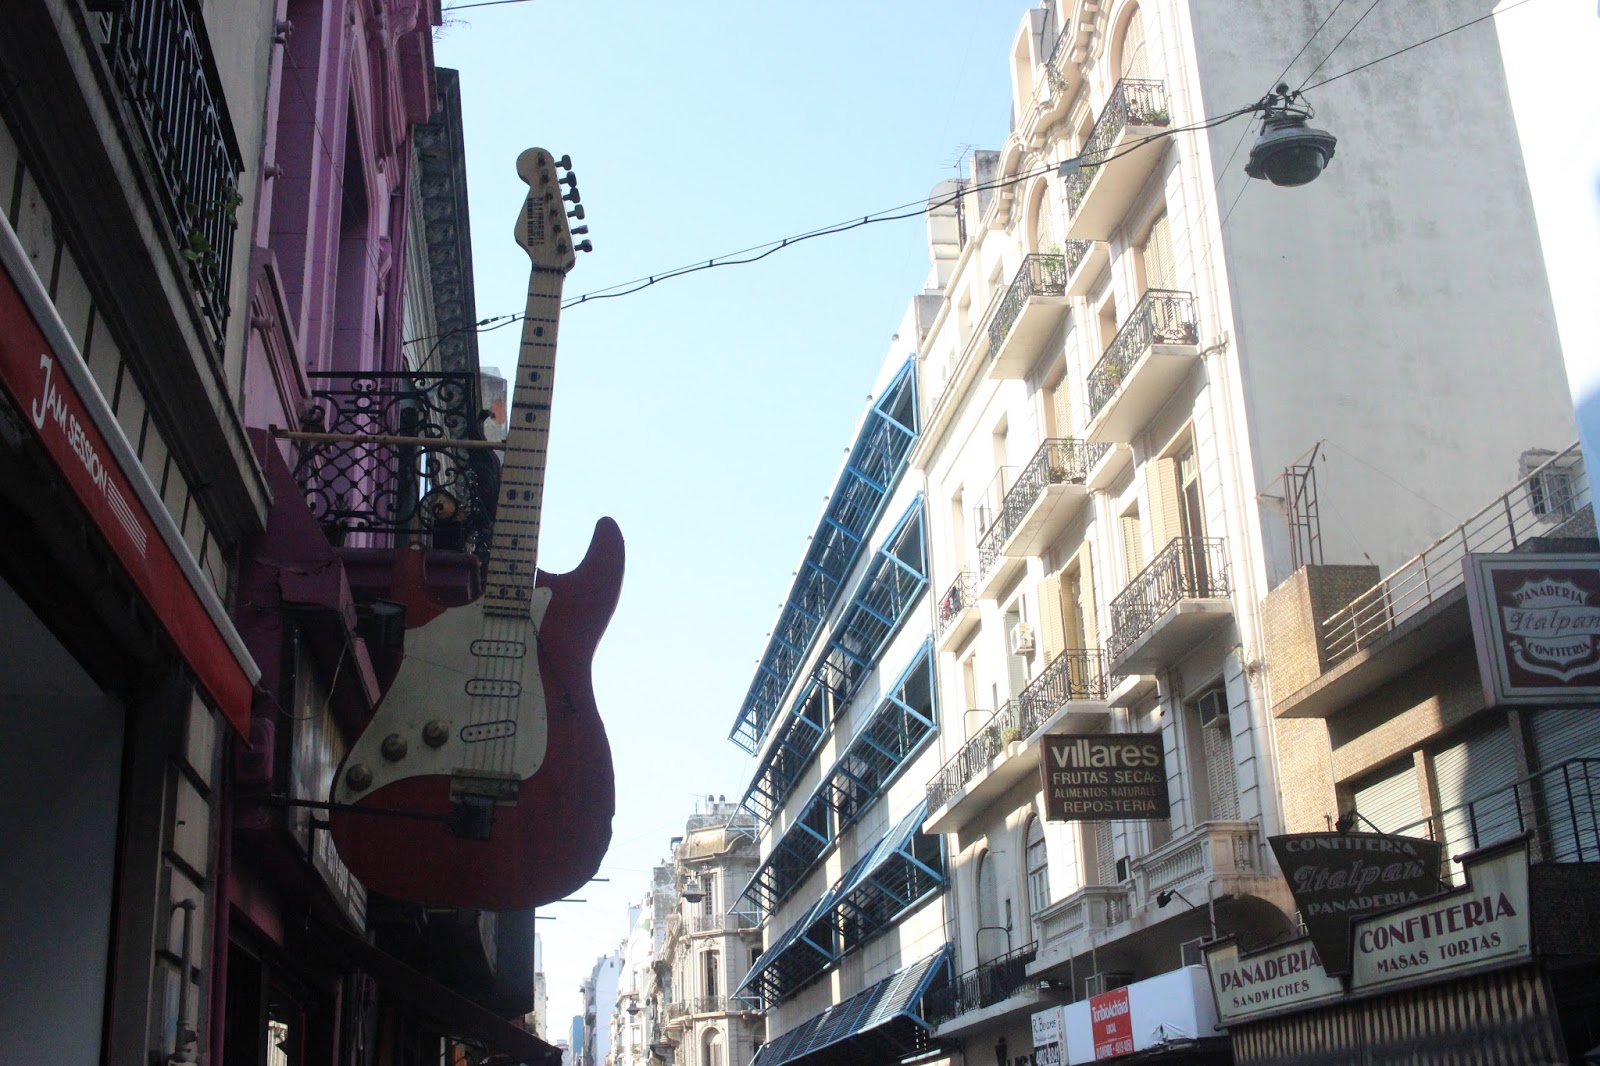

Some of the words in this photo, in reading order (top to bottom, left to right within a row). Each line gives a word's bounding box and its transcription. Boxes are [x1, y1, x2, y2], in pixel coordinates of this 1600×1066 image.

[32, 353, 67, 435] JAM
[67, 414, 107, 496] SESSION
[1516, 584, 1583, 604] PANADERIA
[1509, 609, 1600, 635] Italpan
[1527, 641, 1590, 657] CONFITERIA
[1051, 738, 1160, 768] villares
[1052, 771, 1108, 785] FRUTAS
[1114, 770, 1162, 784] SECAS
[1054, 787, 1108, 799] ALIMENTOS
[1111, 786, 1161, 798] NATURALE
[1063, 799, 1156, 813] REPOSTERIA
[1285, 837, 1418, 856] CONFITERIA
[1293, 859, 1425, 894] Italpan
[1307, 890, 1417, 916] PANADERIA
[1359, 892, 1517, 954] CONFITERIA
[1377, 950, 1429, 974] MASAS
[1438, 931, 1502, 960] TORTAS
[1220, 947, 1323, 992] PANADERIA
[1233, 979, 1310, 1008] SANDWICHES
